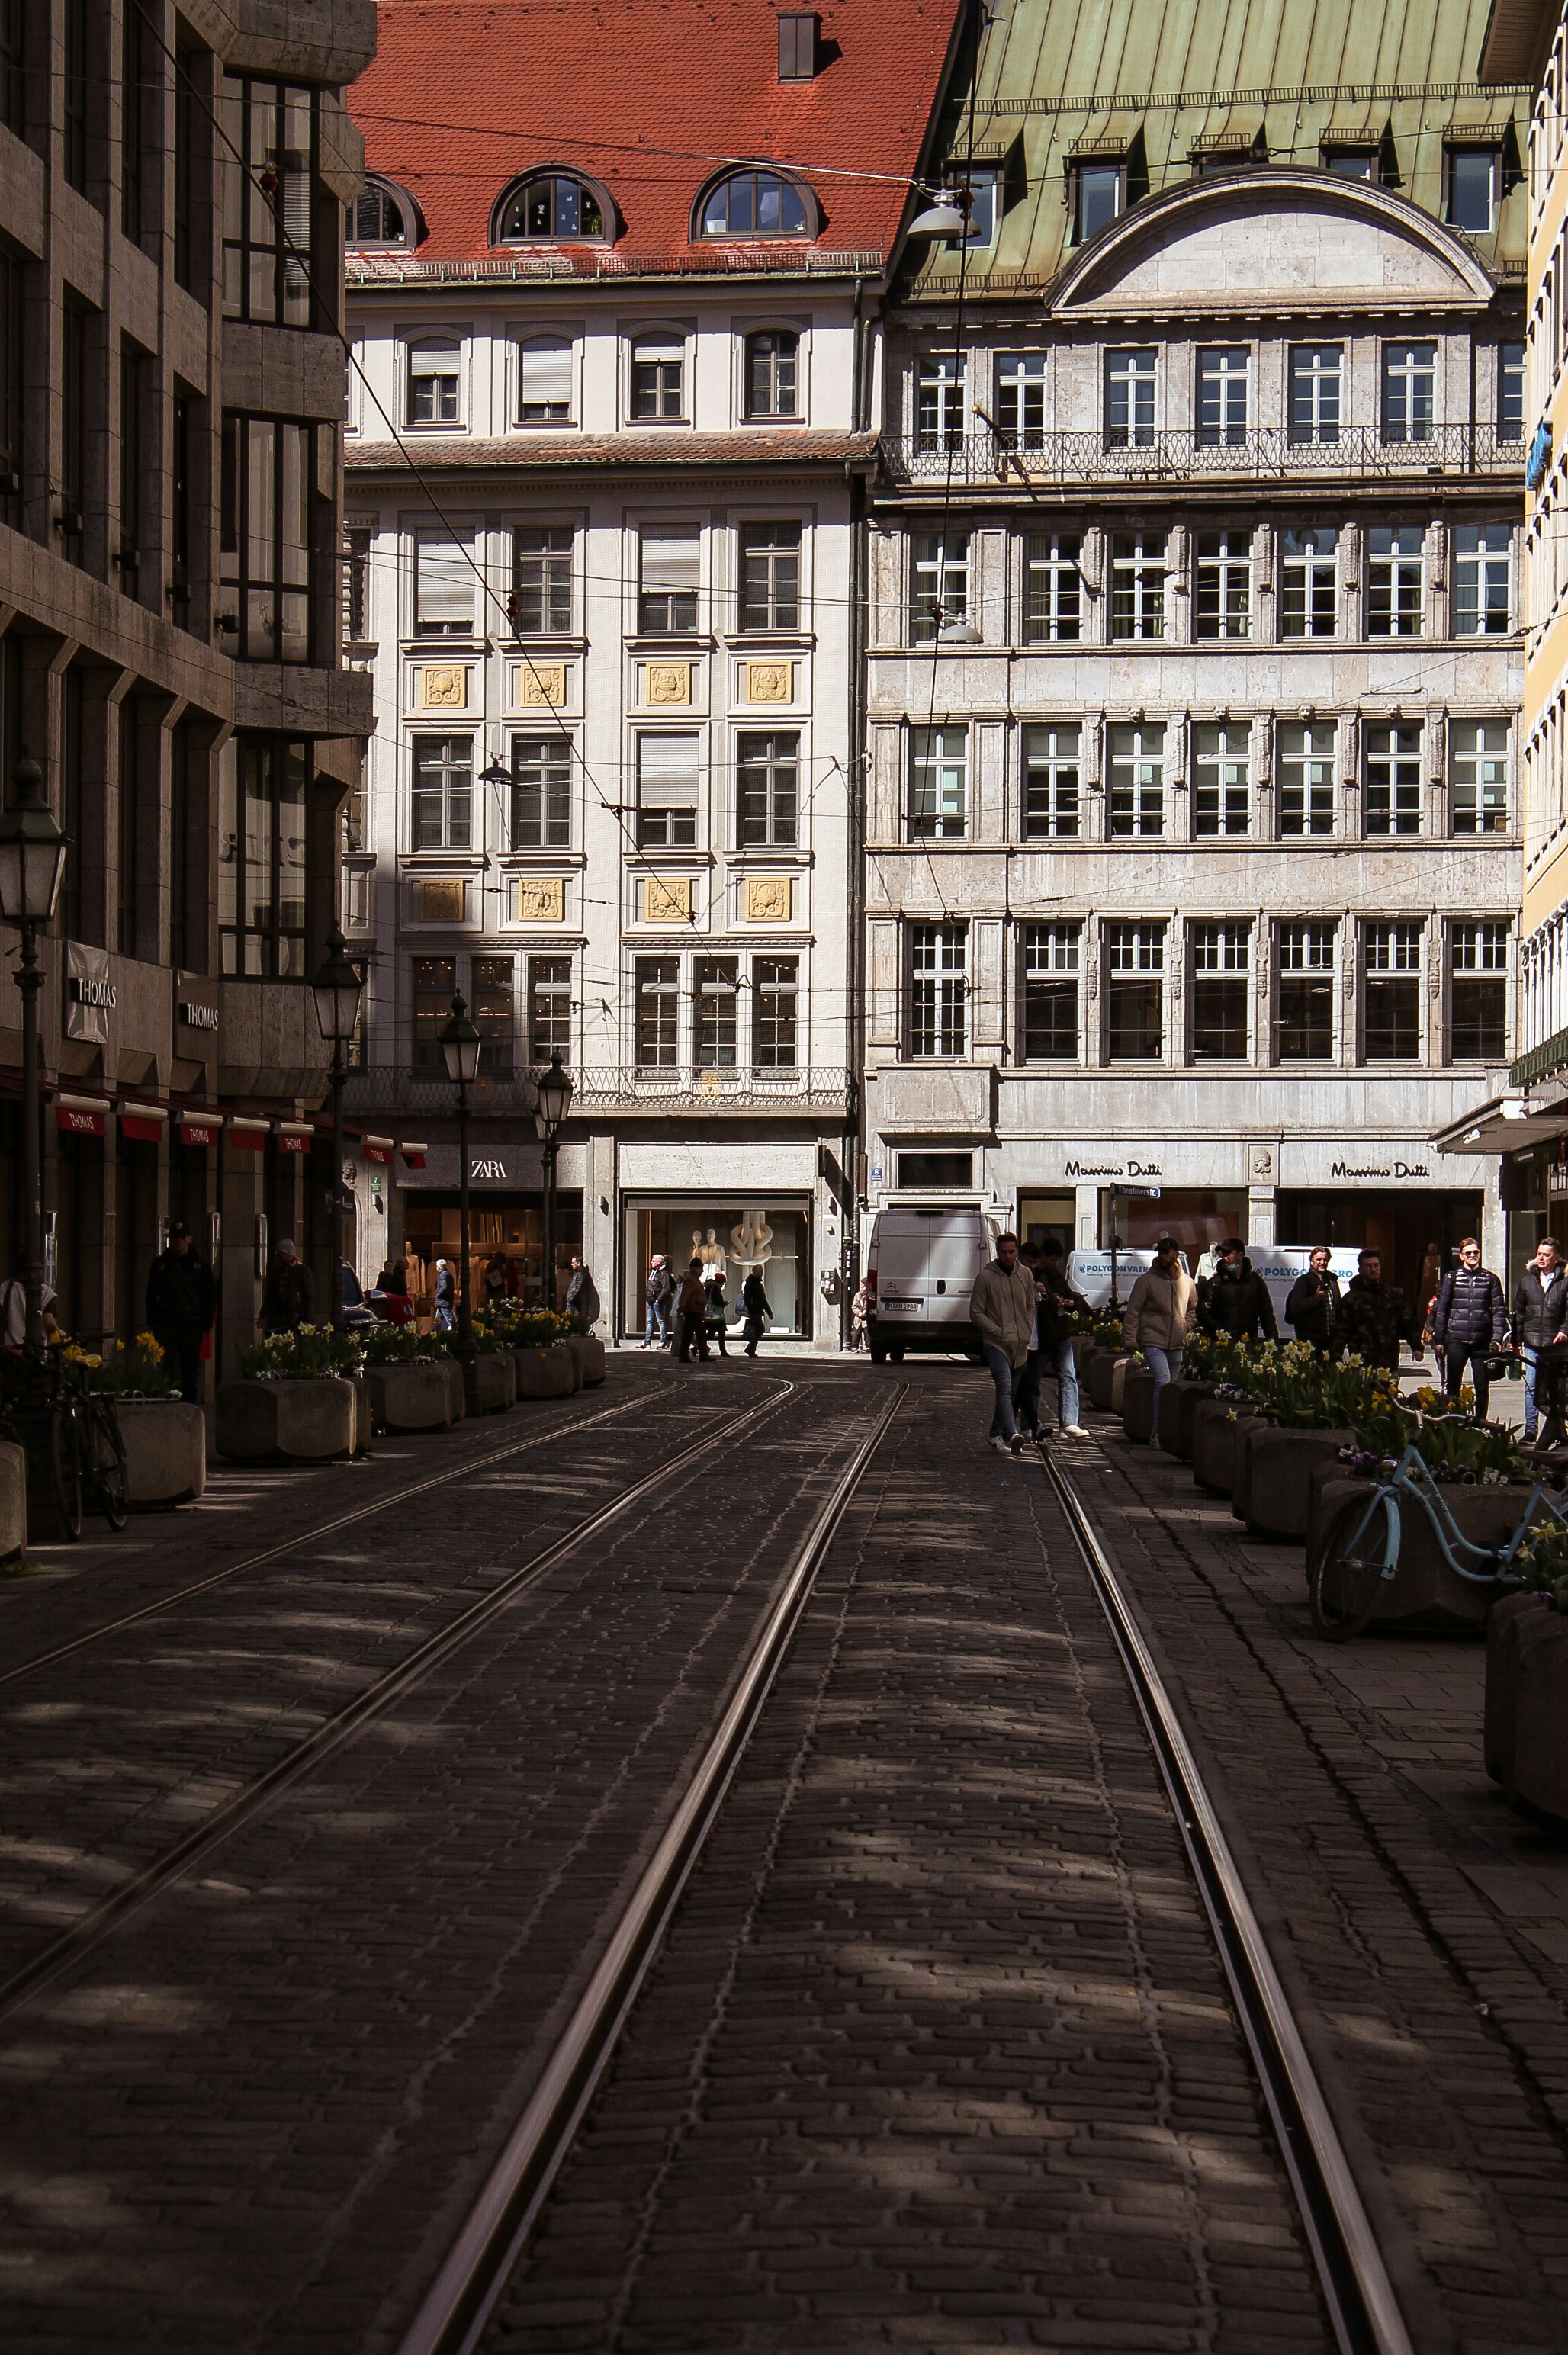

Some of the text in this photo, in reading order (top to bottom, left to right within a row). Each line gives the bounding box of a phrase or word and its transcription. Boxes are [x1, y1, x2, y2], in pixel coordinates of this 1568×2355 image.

[78, 977, 117, 1009] THOMAS
[187, 1002, 219, 1031] THOMAS
[69, 1113, 94, 1129] THOMAS
[189, 1128, 210, 1142] THOMAS
[284, 1137, 302, 1150] THOMAS
[471, 1161, 507, 1178] ZARA
[1065, 1161, 1163, 1177] Massimo Dutti
[1331, 1161, 1430, 1178] Massimo Dutti
[1118, 1185, 1157, 1197] Theatinerstr.
